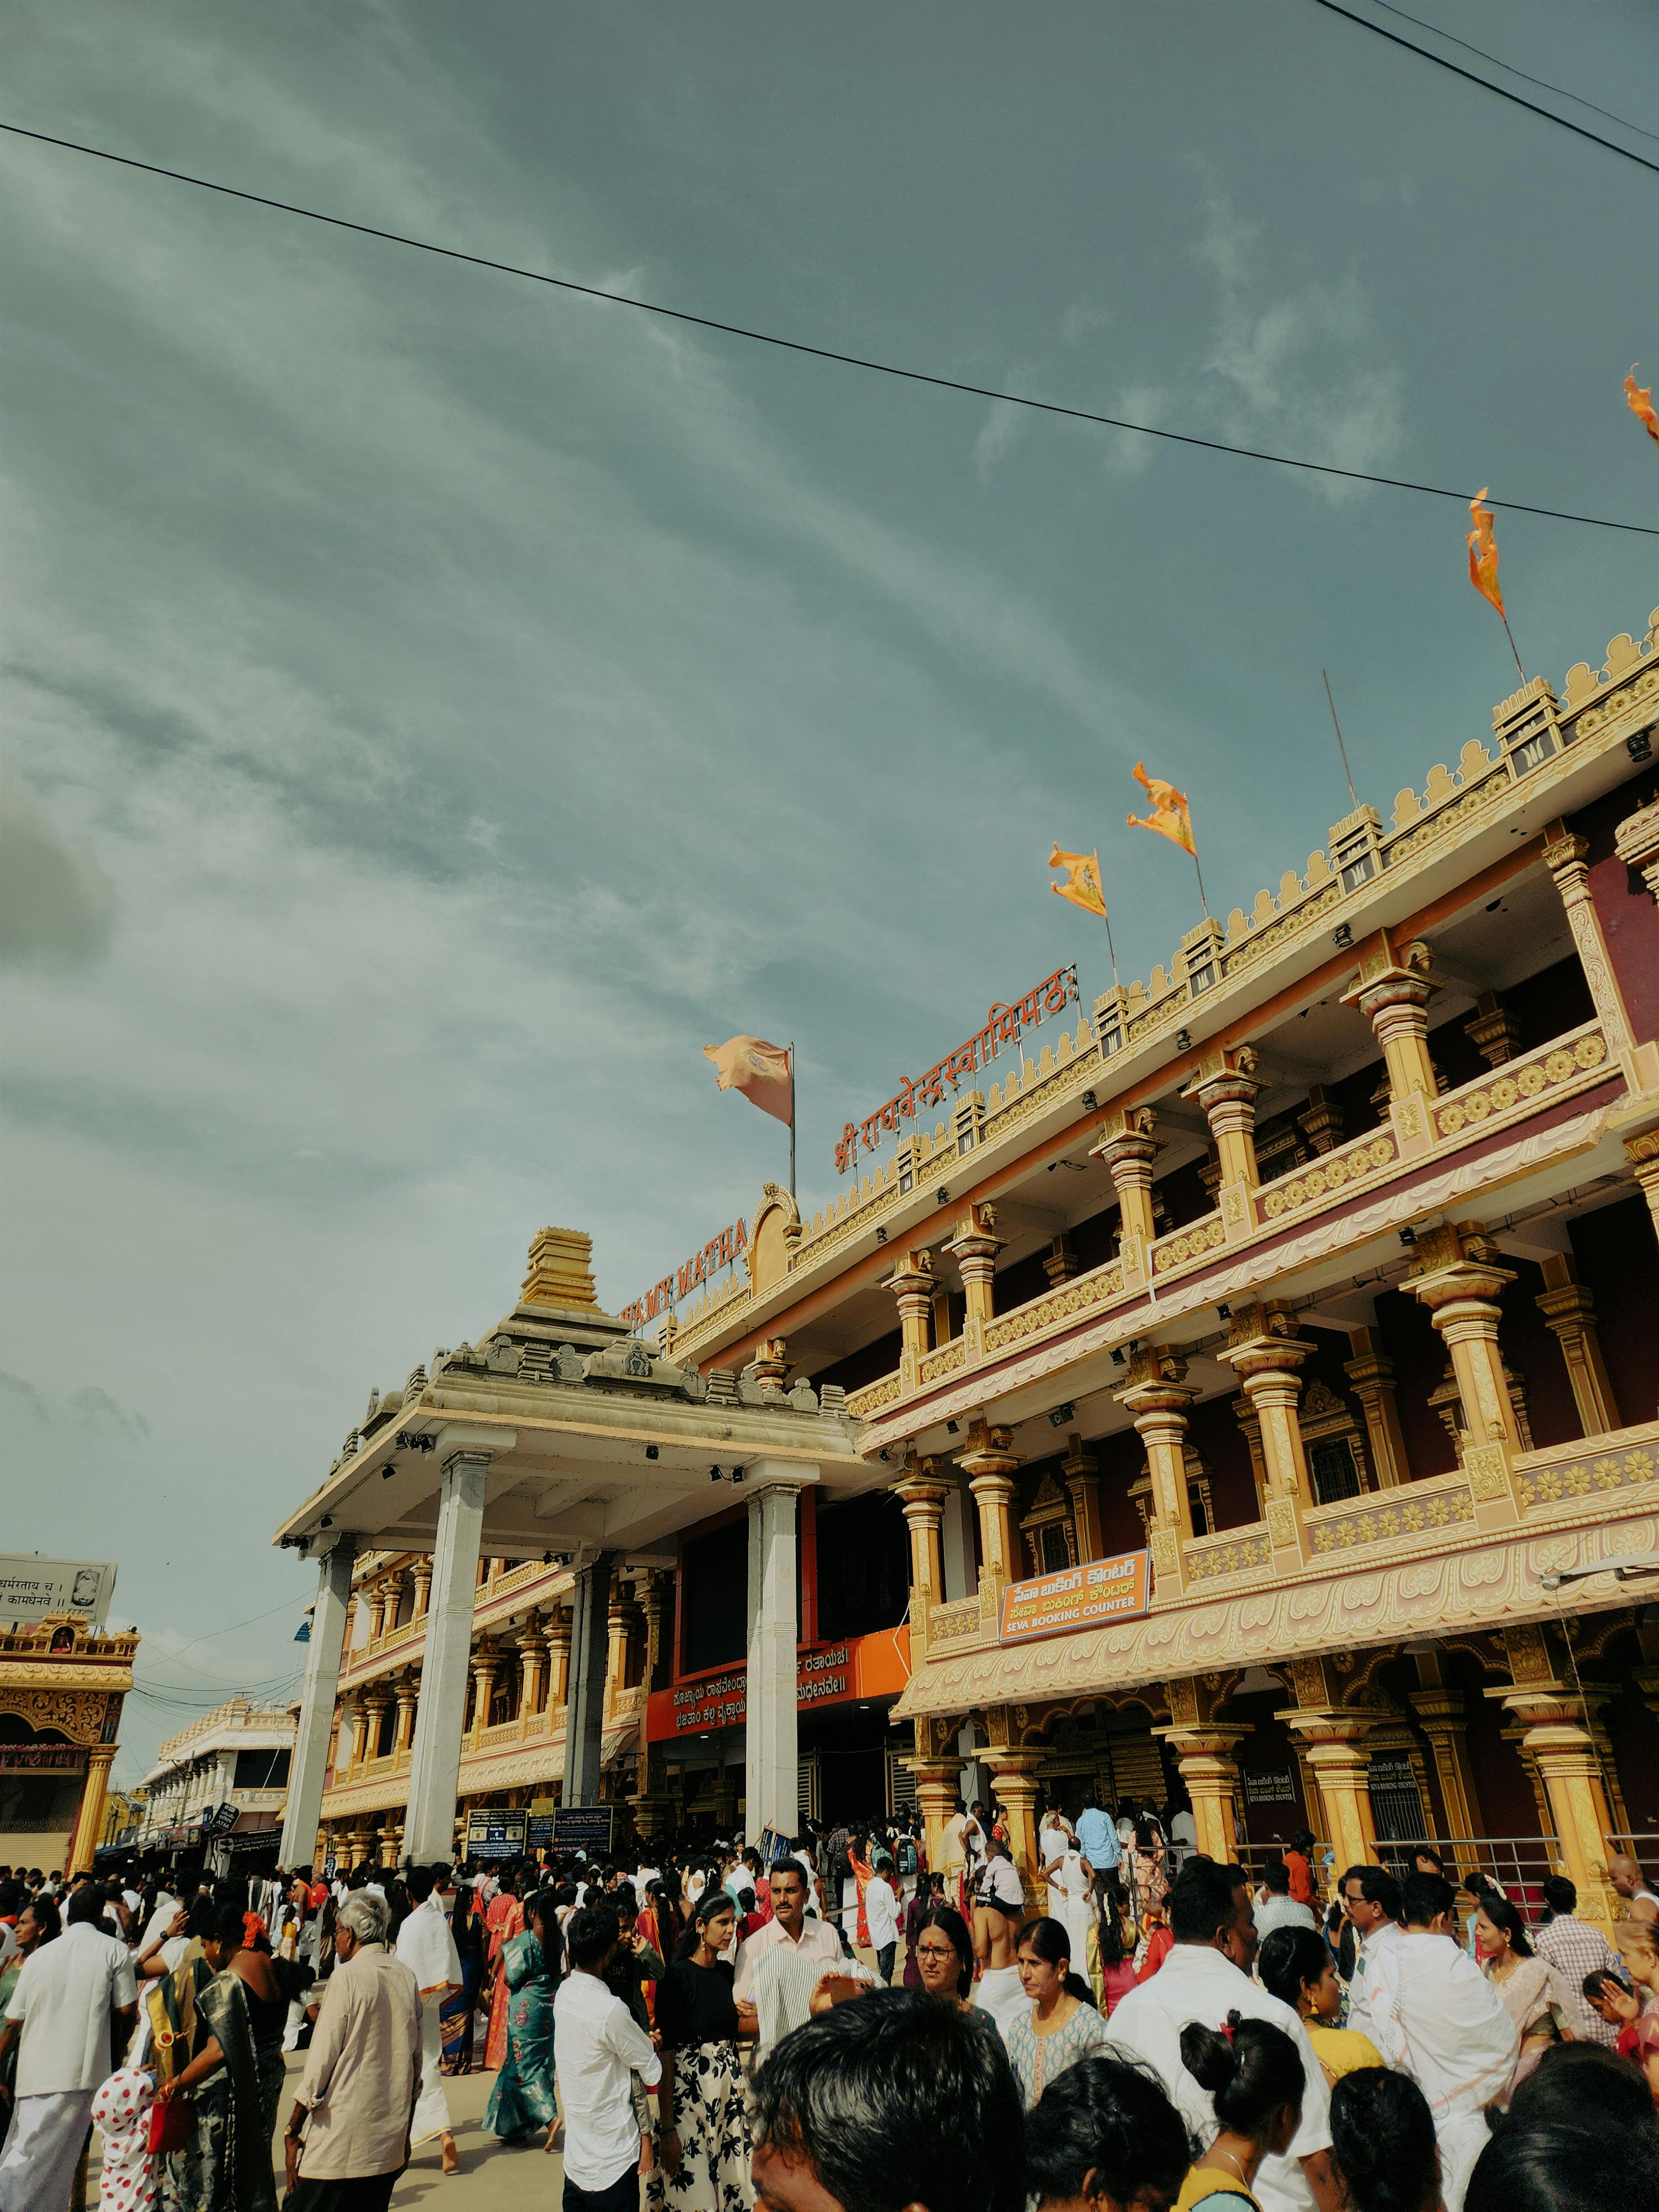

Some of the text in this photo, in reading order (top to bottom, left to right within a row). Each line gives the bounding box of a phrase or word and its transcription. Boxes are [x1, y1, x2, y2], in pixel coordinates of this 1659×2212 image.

[676, 1217, 748, 1301] MATHA
[44, 1582, 54, 1591] च
[1014, 1558, 1136, 1604] సేవా బుకింగ్ కౌంటర్
[8, 1592, 52, 1606] कामधेनवे
[1010, 1578, 1136, 1620] ಸೇವಾ ಬುಕಿಂಗ್ ಕೌಂಟರ್
[1006, 1596, 1136, 1634] SEVA BOOKING COUNTER
[707, 1676, 747, 1698] ರಾಘವೇಂದ್ರಾ
[216, 1819, 229, 1829] ATM
